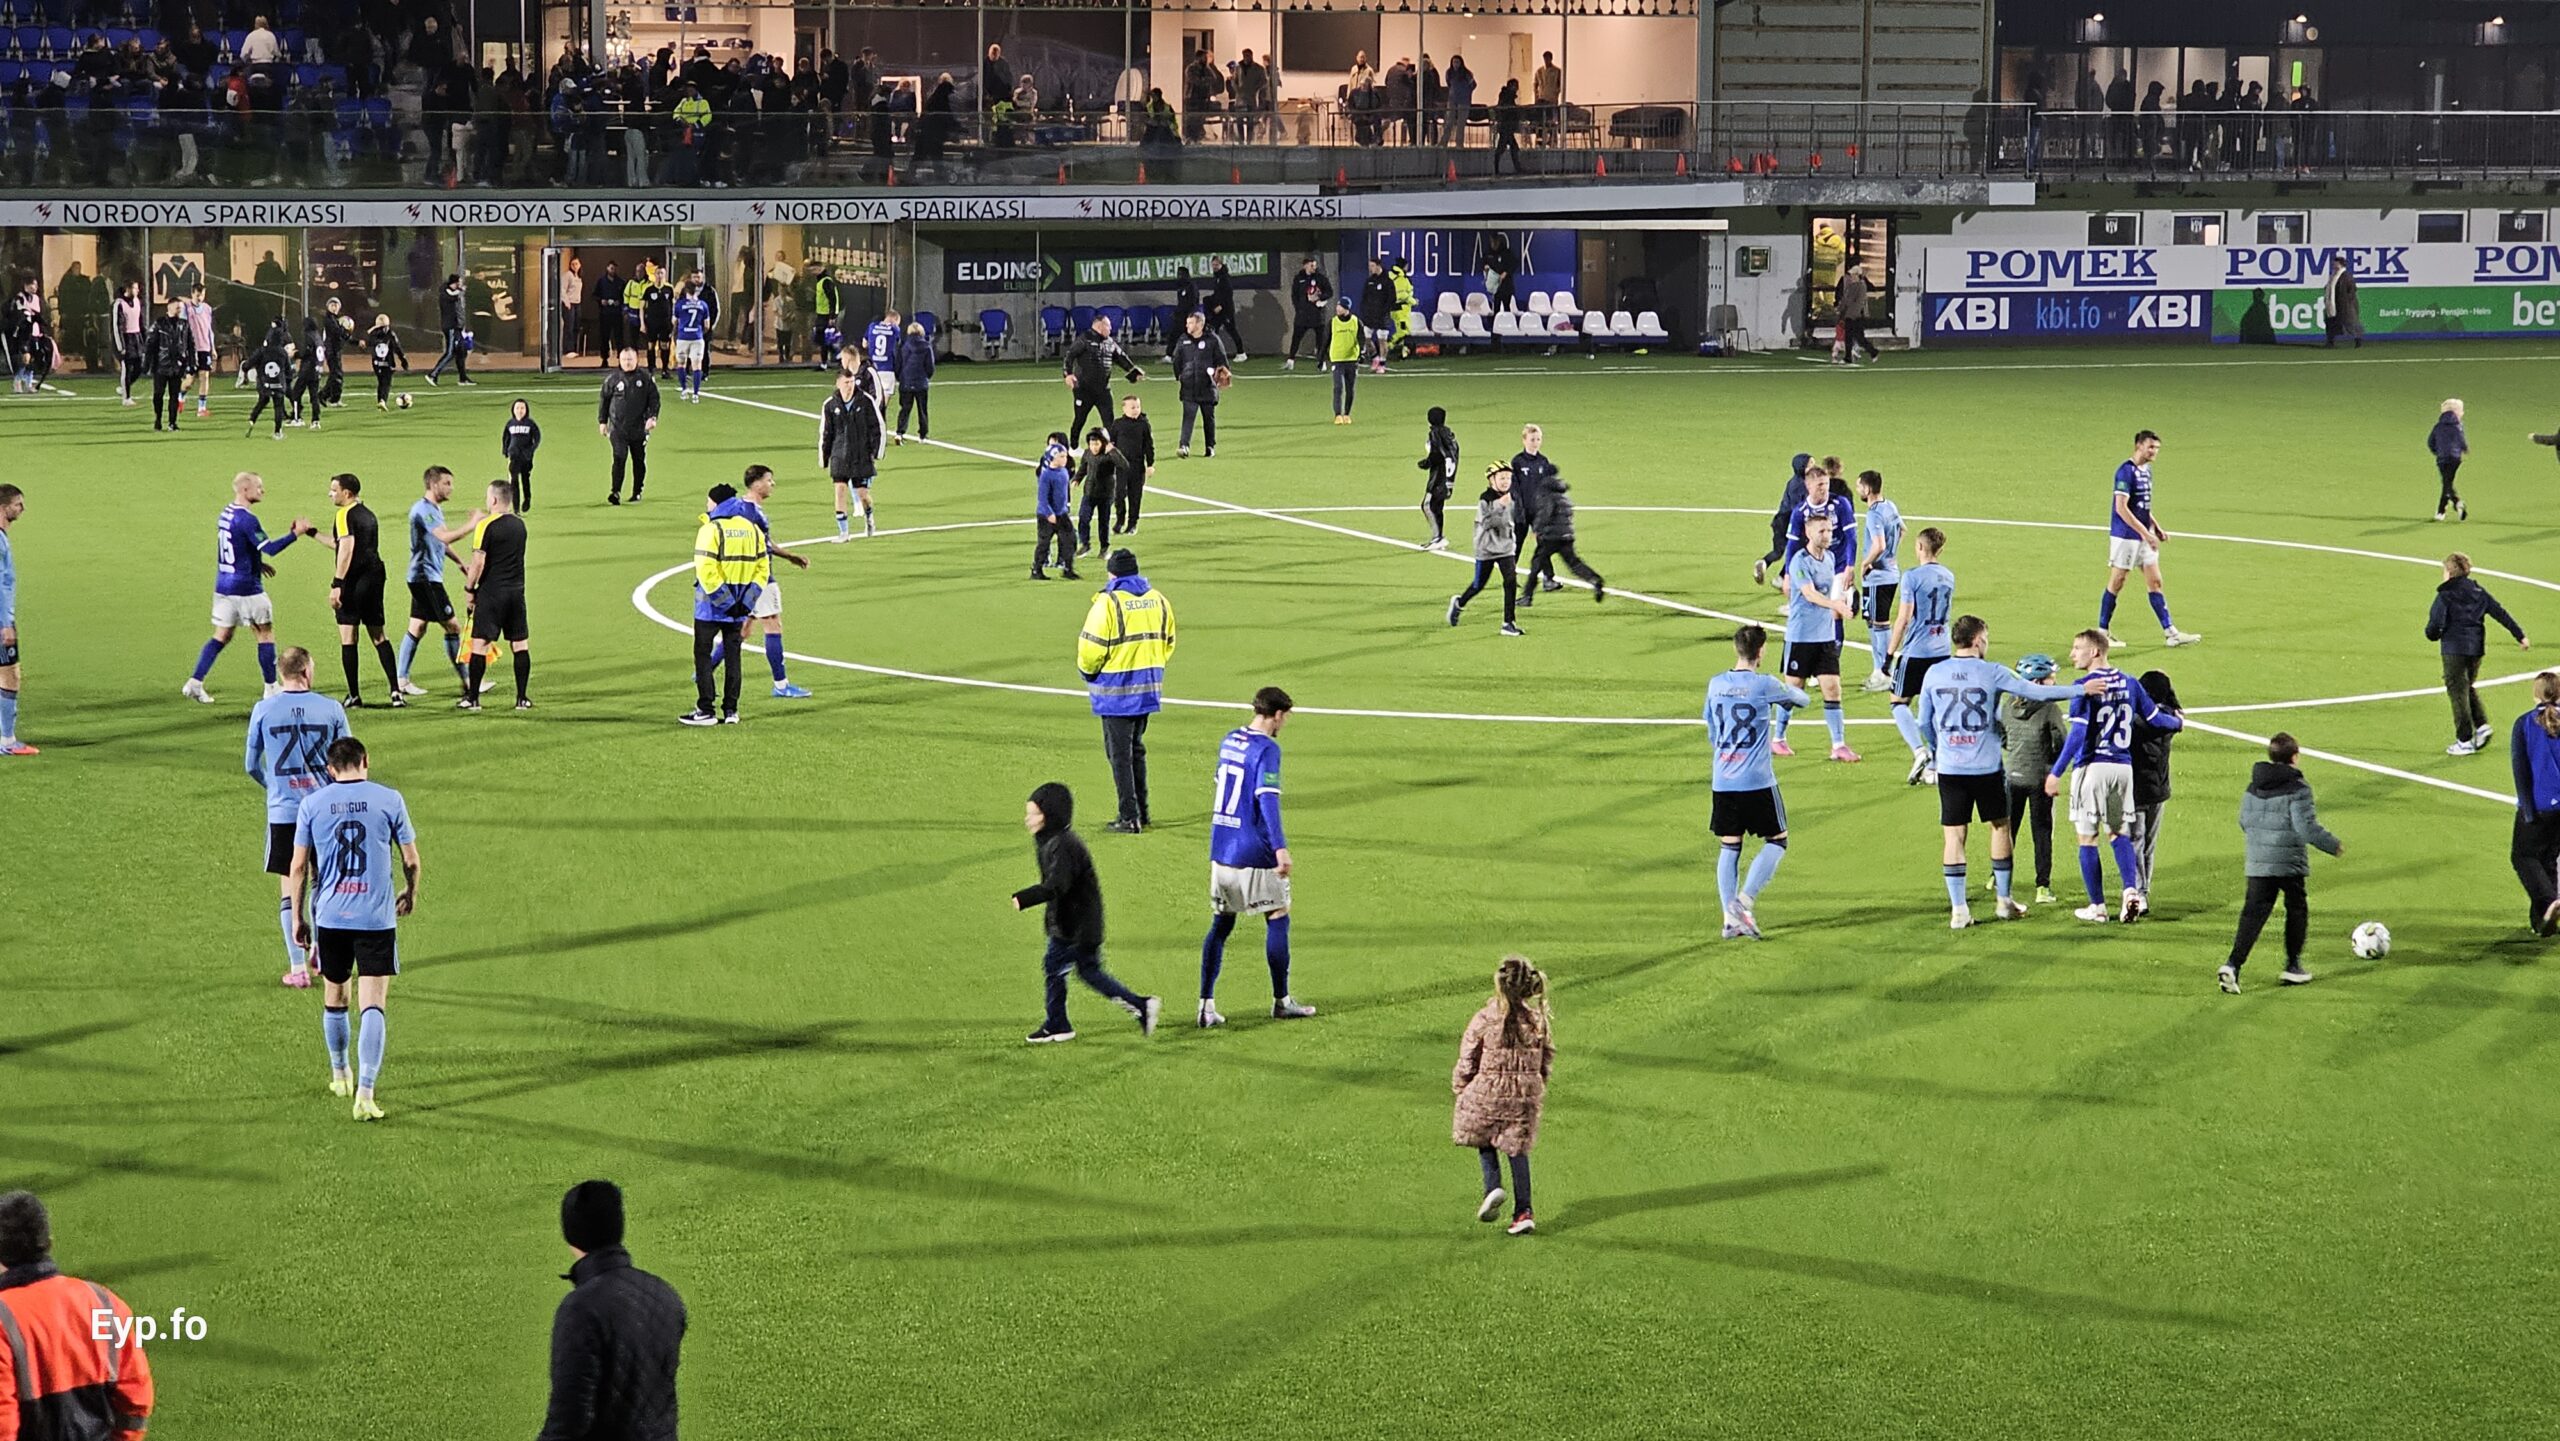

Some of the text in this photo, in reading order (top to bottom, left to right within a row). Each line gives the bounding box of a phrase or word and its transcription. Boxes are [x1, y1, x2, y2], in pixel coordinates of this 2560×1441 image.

[203, 203, 345, 225] SPARIKASSI
[562, 203, 695, 223] SPARIKASSI
[900, 199, 1027, 220] SPARIKASSI
[1221, 198, 1343, 218] SPARIKASSI
[957, 261, 1042, 281] ELDING
[1080, 262, 1102, 283] VIT
[1109, 260, 1151, 282] VILJA
[1966, 250, 2157, 287] POMEK
[688, 309, 698, 328] 7
[1935, 295, 2201, 331] KBI kbi.fo KBI
[875, 334, 887, 356] 9
[1714, 703, 1757, 749] 18
[2096, 703, 2133, 749] 23
[1213, 763, 1245, 815] 17
[334, 820, 367, 877] 8
